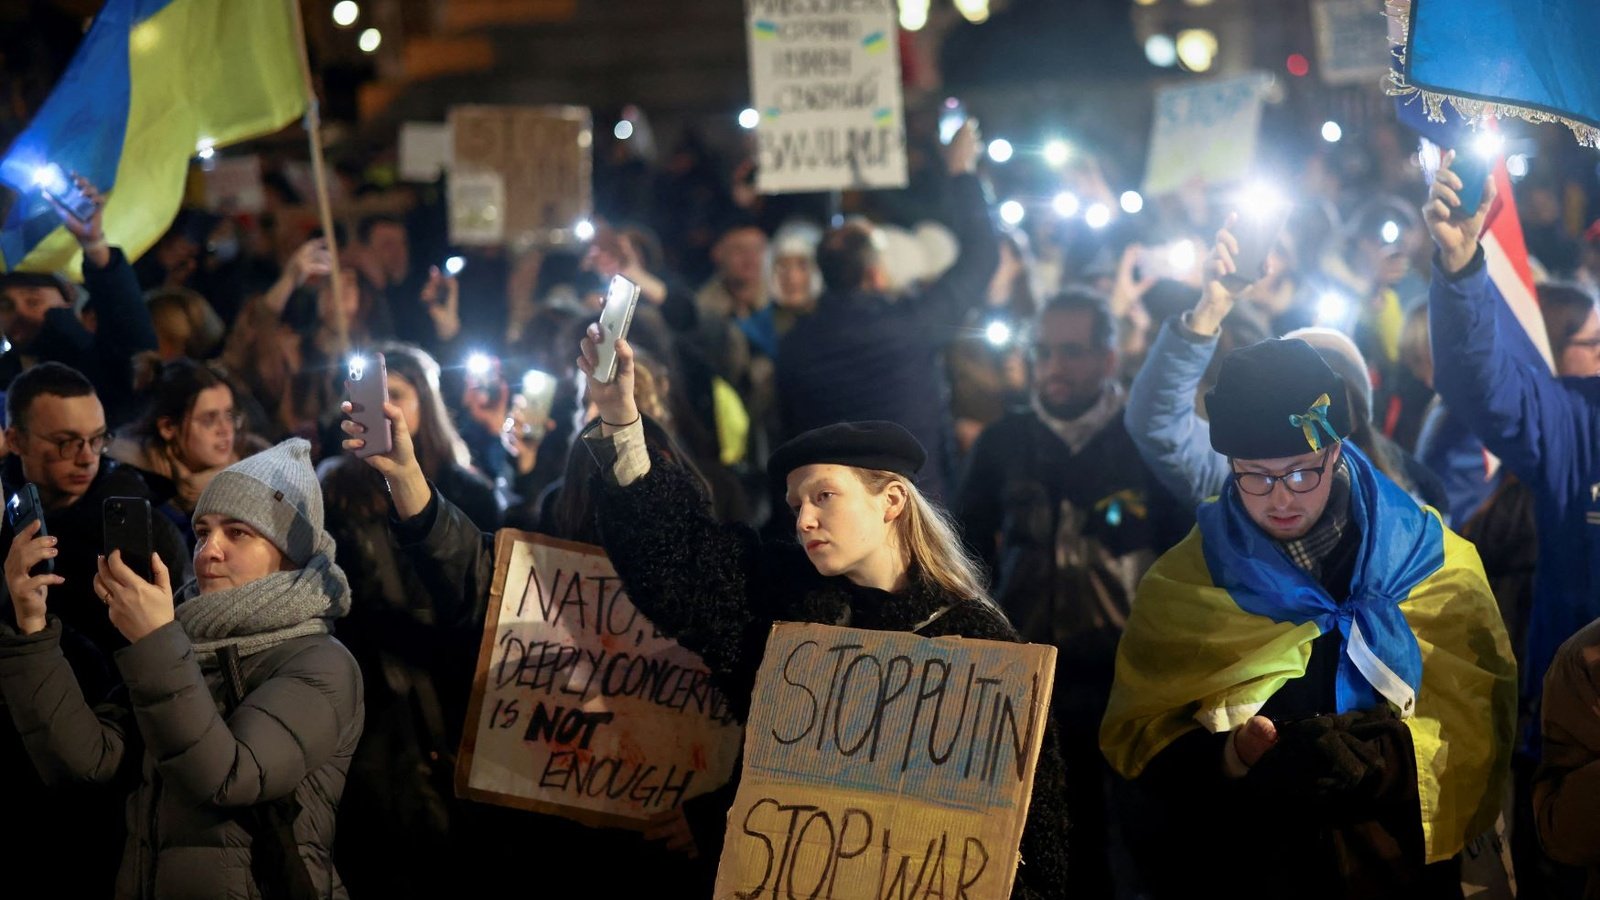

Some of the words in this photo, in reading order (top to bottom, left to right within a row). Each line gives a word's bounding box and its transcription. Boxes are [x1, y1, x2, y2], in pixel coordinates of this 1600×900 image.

[517, 566, 642, 646] NATO,
[489, 700, 519, 729] IS
[523, 702, 614, 749] NOT
[772, 641, 914, 762] STOP
[901, 658, 1038, 782] PUTIN
[538, 751, 694, 808] ENOUGH
[734, 798, 873, 900] STOP
[876, 827, 989, 900] WAR
